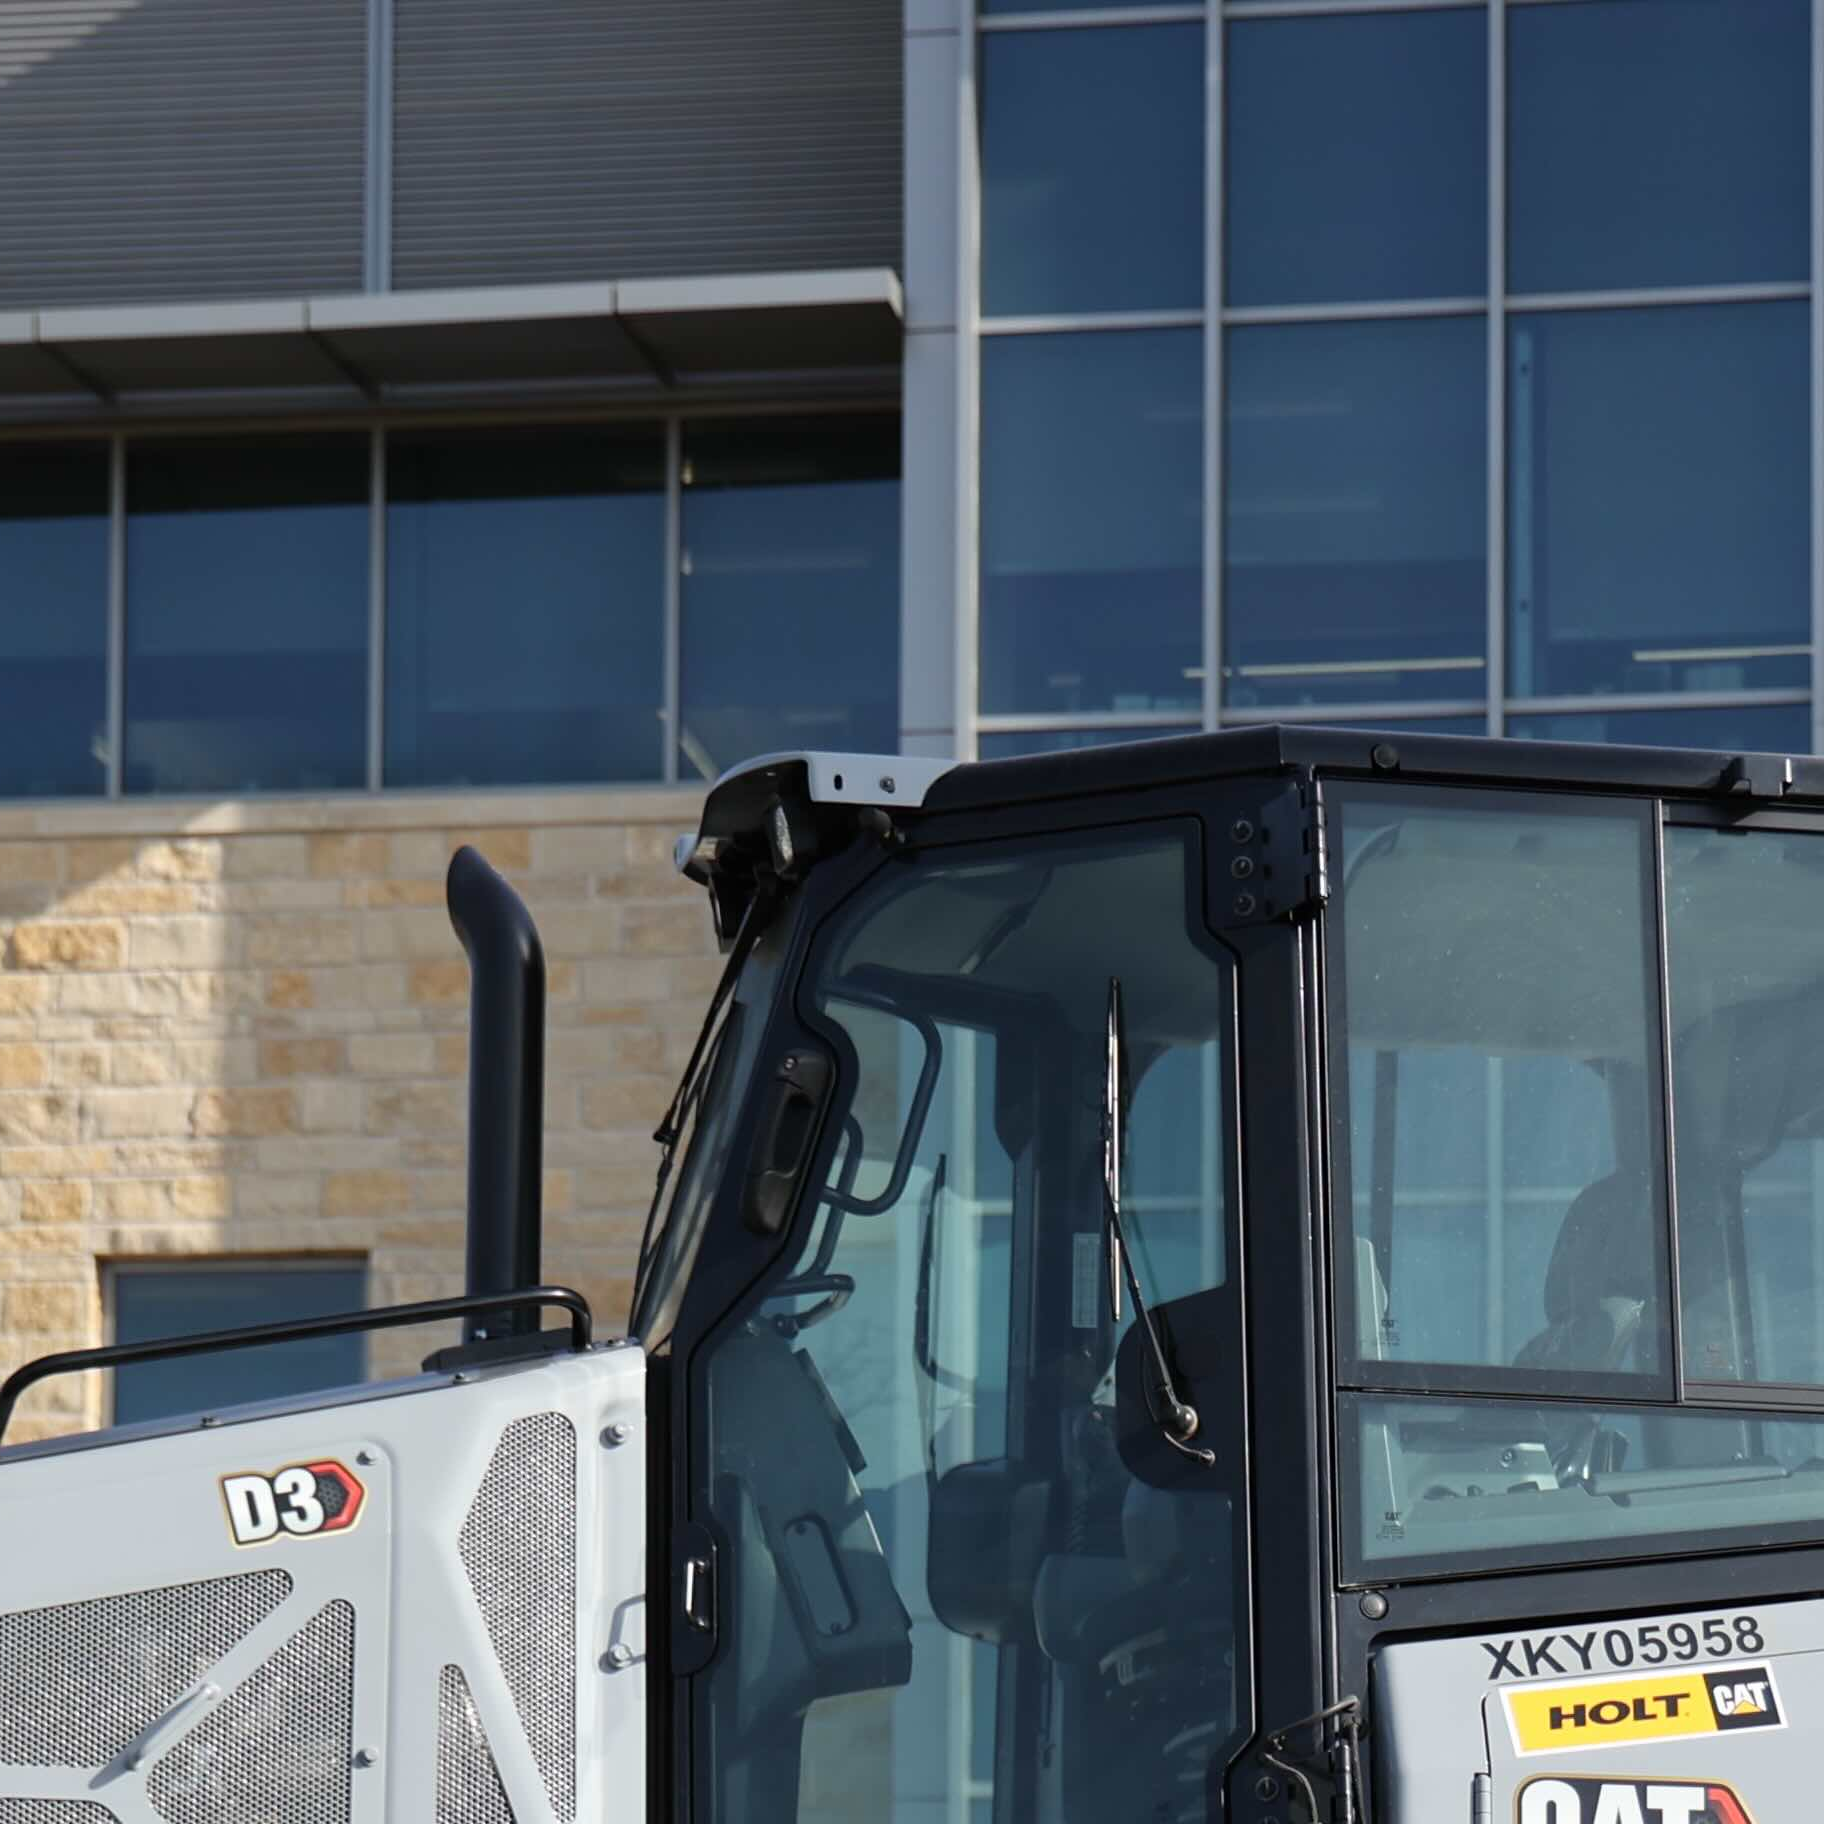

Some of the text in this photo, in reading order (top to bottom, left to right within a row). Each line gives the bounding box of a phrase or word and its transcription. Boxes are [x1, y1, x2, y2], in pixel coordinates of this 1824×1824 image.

[224, 1467, 324, 1542] D3
[1480, 1615, 1765, 1680] XKY05958
[1549, 1681, 1768, 1730] HOLT CAT
